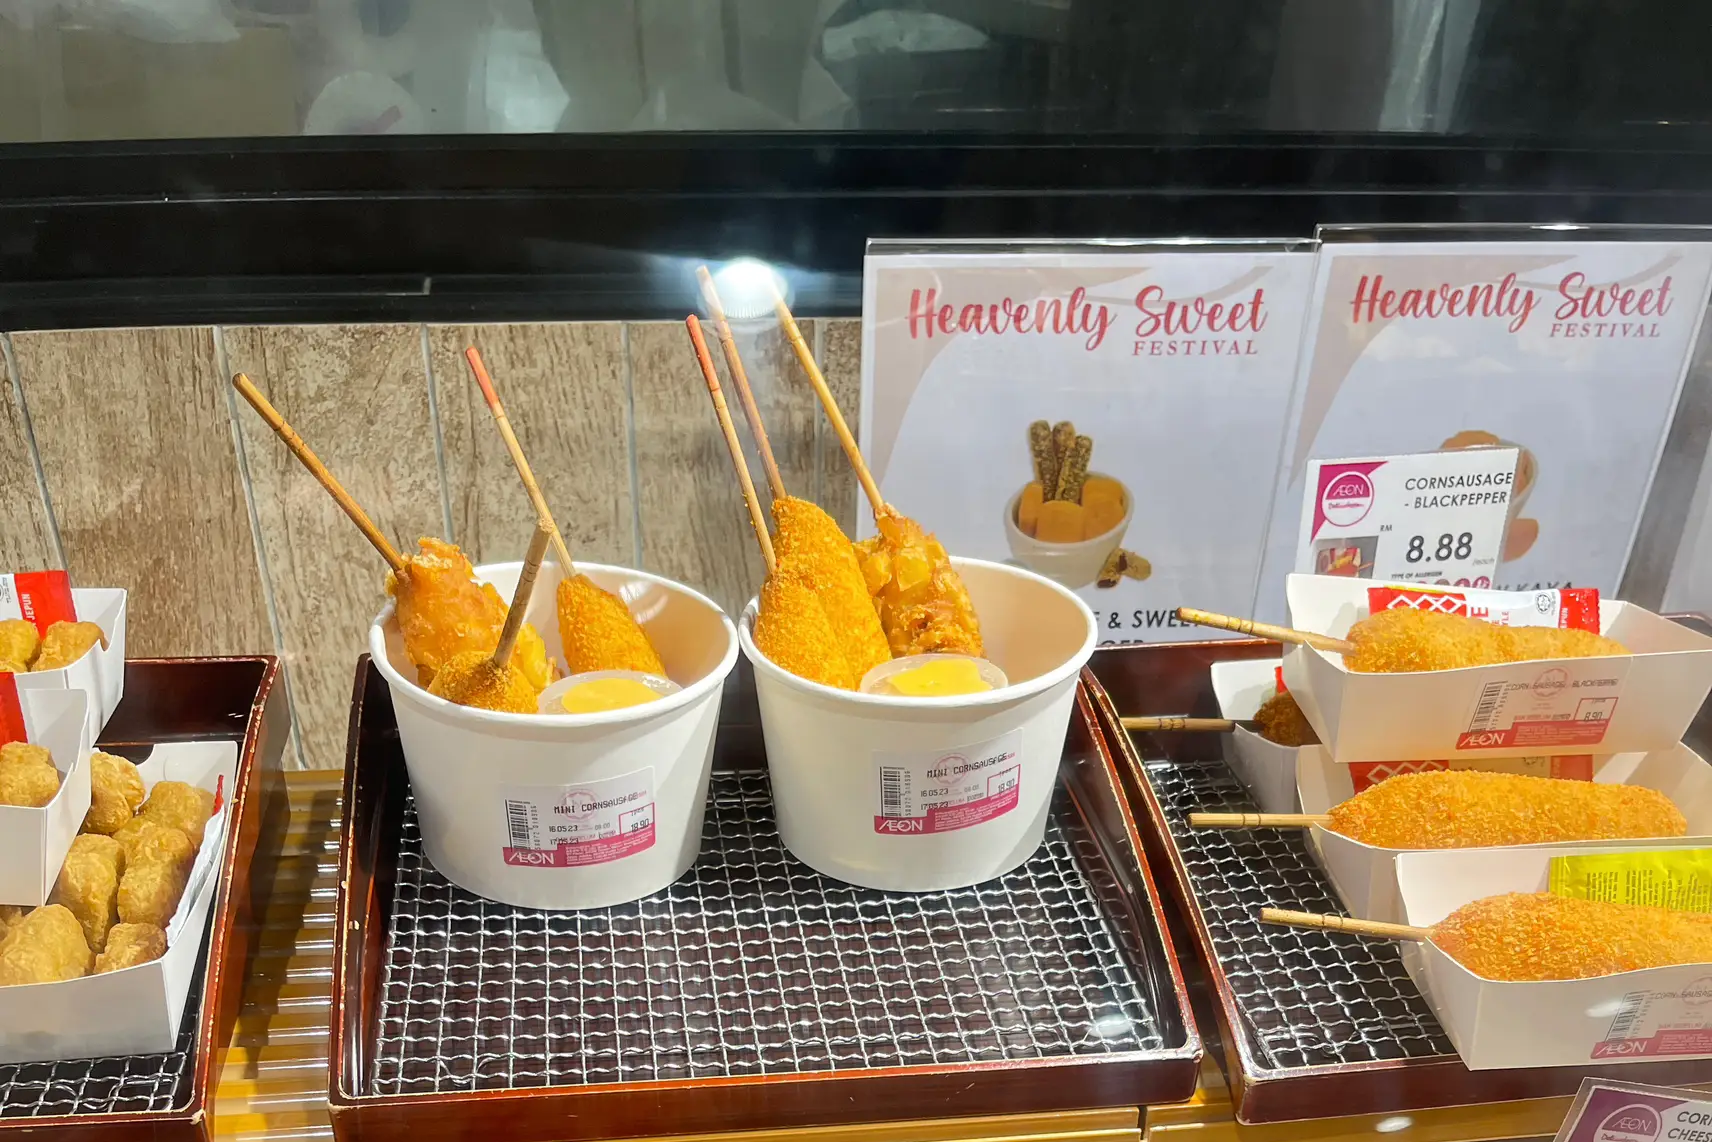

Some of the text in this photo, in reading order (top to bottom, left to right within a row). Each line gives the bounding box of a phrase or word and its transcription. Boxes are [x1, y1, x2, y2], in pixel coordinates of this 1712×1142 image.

[1349, 271, 1674, 333] Heavenly Sweet
[905, 285, 1268, 351] Heavenly Sweet
[1549, 322, 1661, 338] FESTIVAL
[1132, 340, 1259, 356] FESTIVAL
[1405, 472, 1514, 490] CORNSAUSAGE
[1414, 491, 1507, 509] BLACKPEPPER
[1405, 532, 1473, 563] 8.88
[1108, 612, 1122, 629] &
[1131, 610, 1201, 628] SWE
[927, 769, 948, 778] MINI
[554, 805, 576, 815] MINI
[1677, 1111, 1712, 1126] COR
